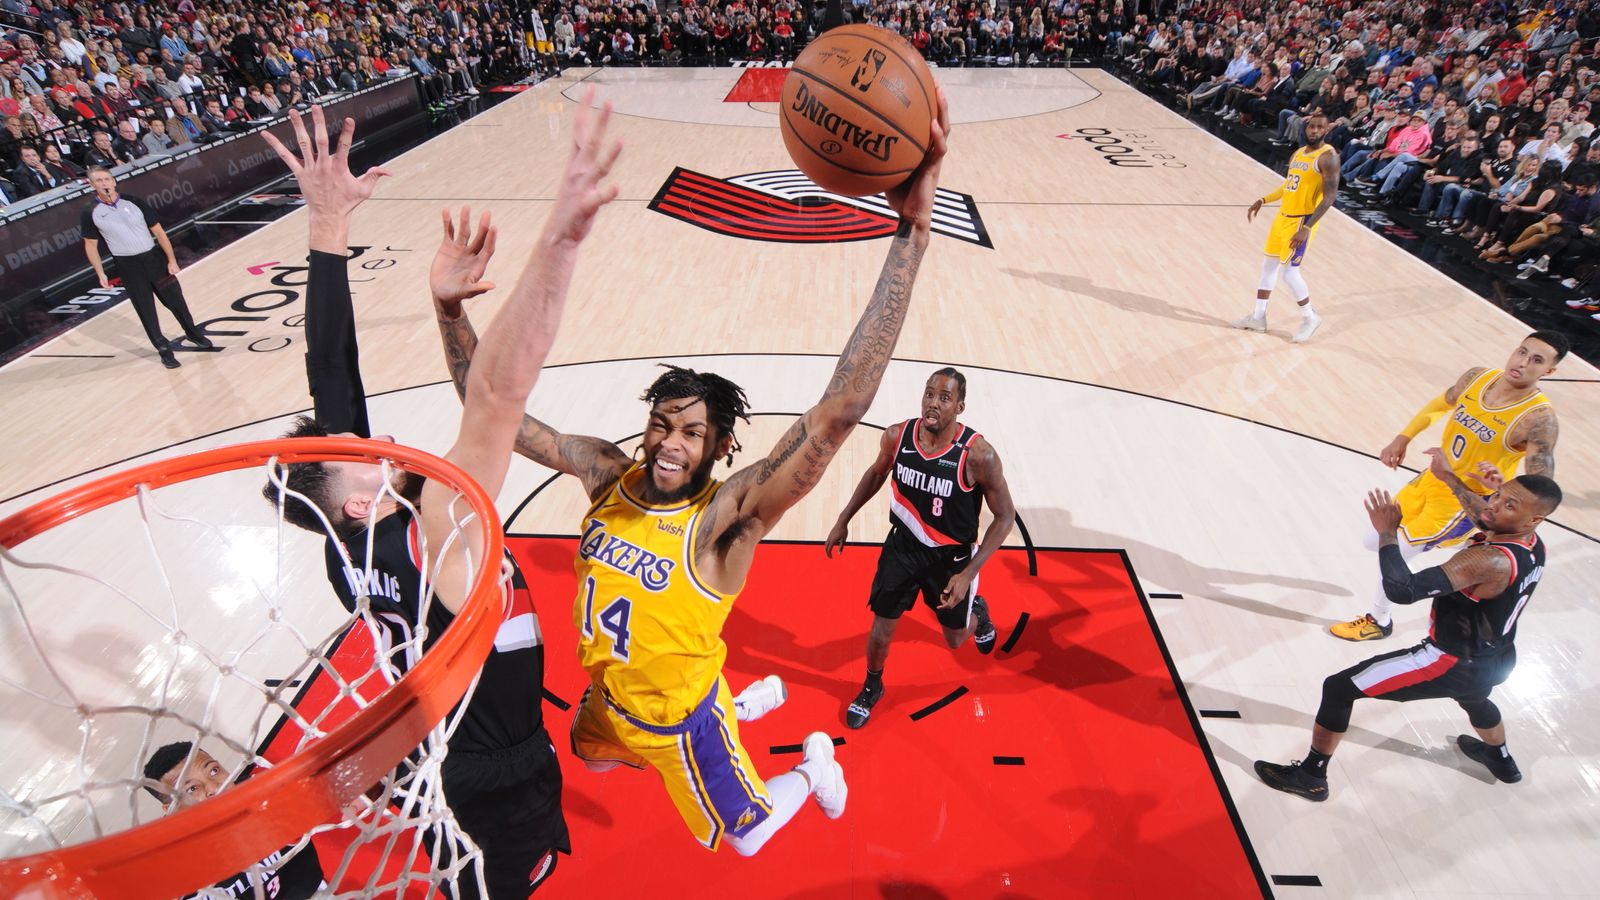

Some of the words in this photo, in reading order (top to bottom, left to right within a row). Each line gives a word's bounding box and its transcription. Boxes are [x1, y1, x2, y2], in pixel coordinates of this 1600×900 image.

[791, 80, 898, 162] SPALDING
[1069, 127, 1153, 168] moda
[147, 179, 195, 210] moda
[1286, 173, 1301, 192] 23
[5, 239, 55, 271] DELTA
[1454, 404, 1497, 443] LAKERS
[1452, 434, 1467, 460] 0
[896, 462, 954, 498] PORTLAND
[931, 497, 944, 517] 8
[657, 518, 685, 537] wish
[579, 518, 676, 593] LAKERS
[581, 575, 633, 665] 14
[266, 875, 281, 900] 3
